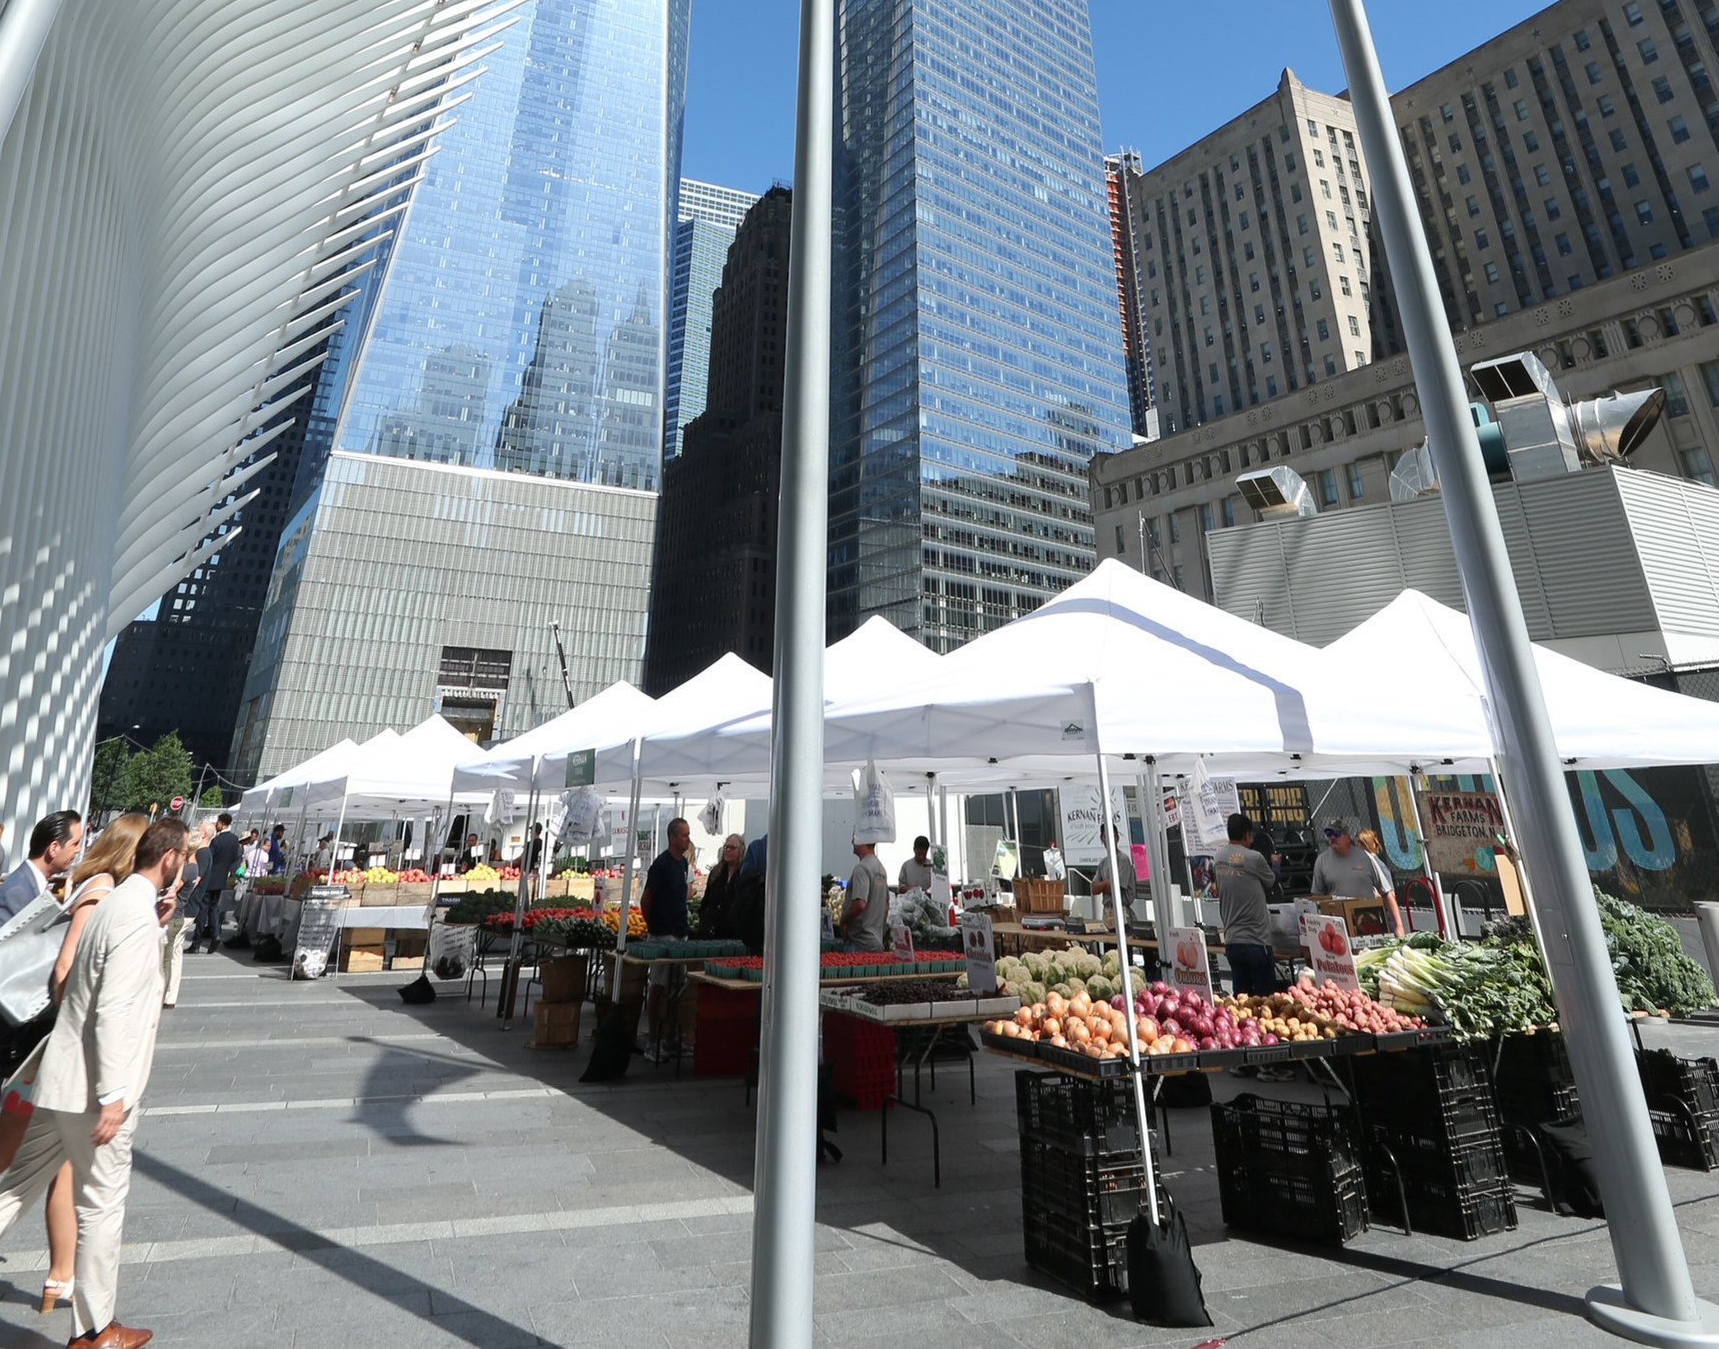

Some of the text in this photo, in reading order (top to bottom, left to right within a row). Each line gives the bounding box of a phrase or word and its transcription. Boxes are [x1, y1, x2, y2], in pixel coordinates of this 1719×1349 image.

[1067, 809, 1096, 824] KERNAN
[1428, 796, 1504, 827] KERNAN
[1451, 810, 1485, 823] FARMS
[1174, 967, 1208, 986] Onions
